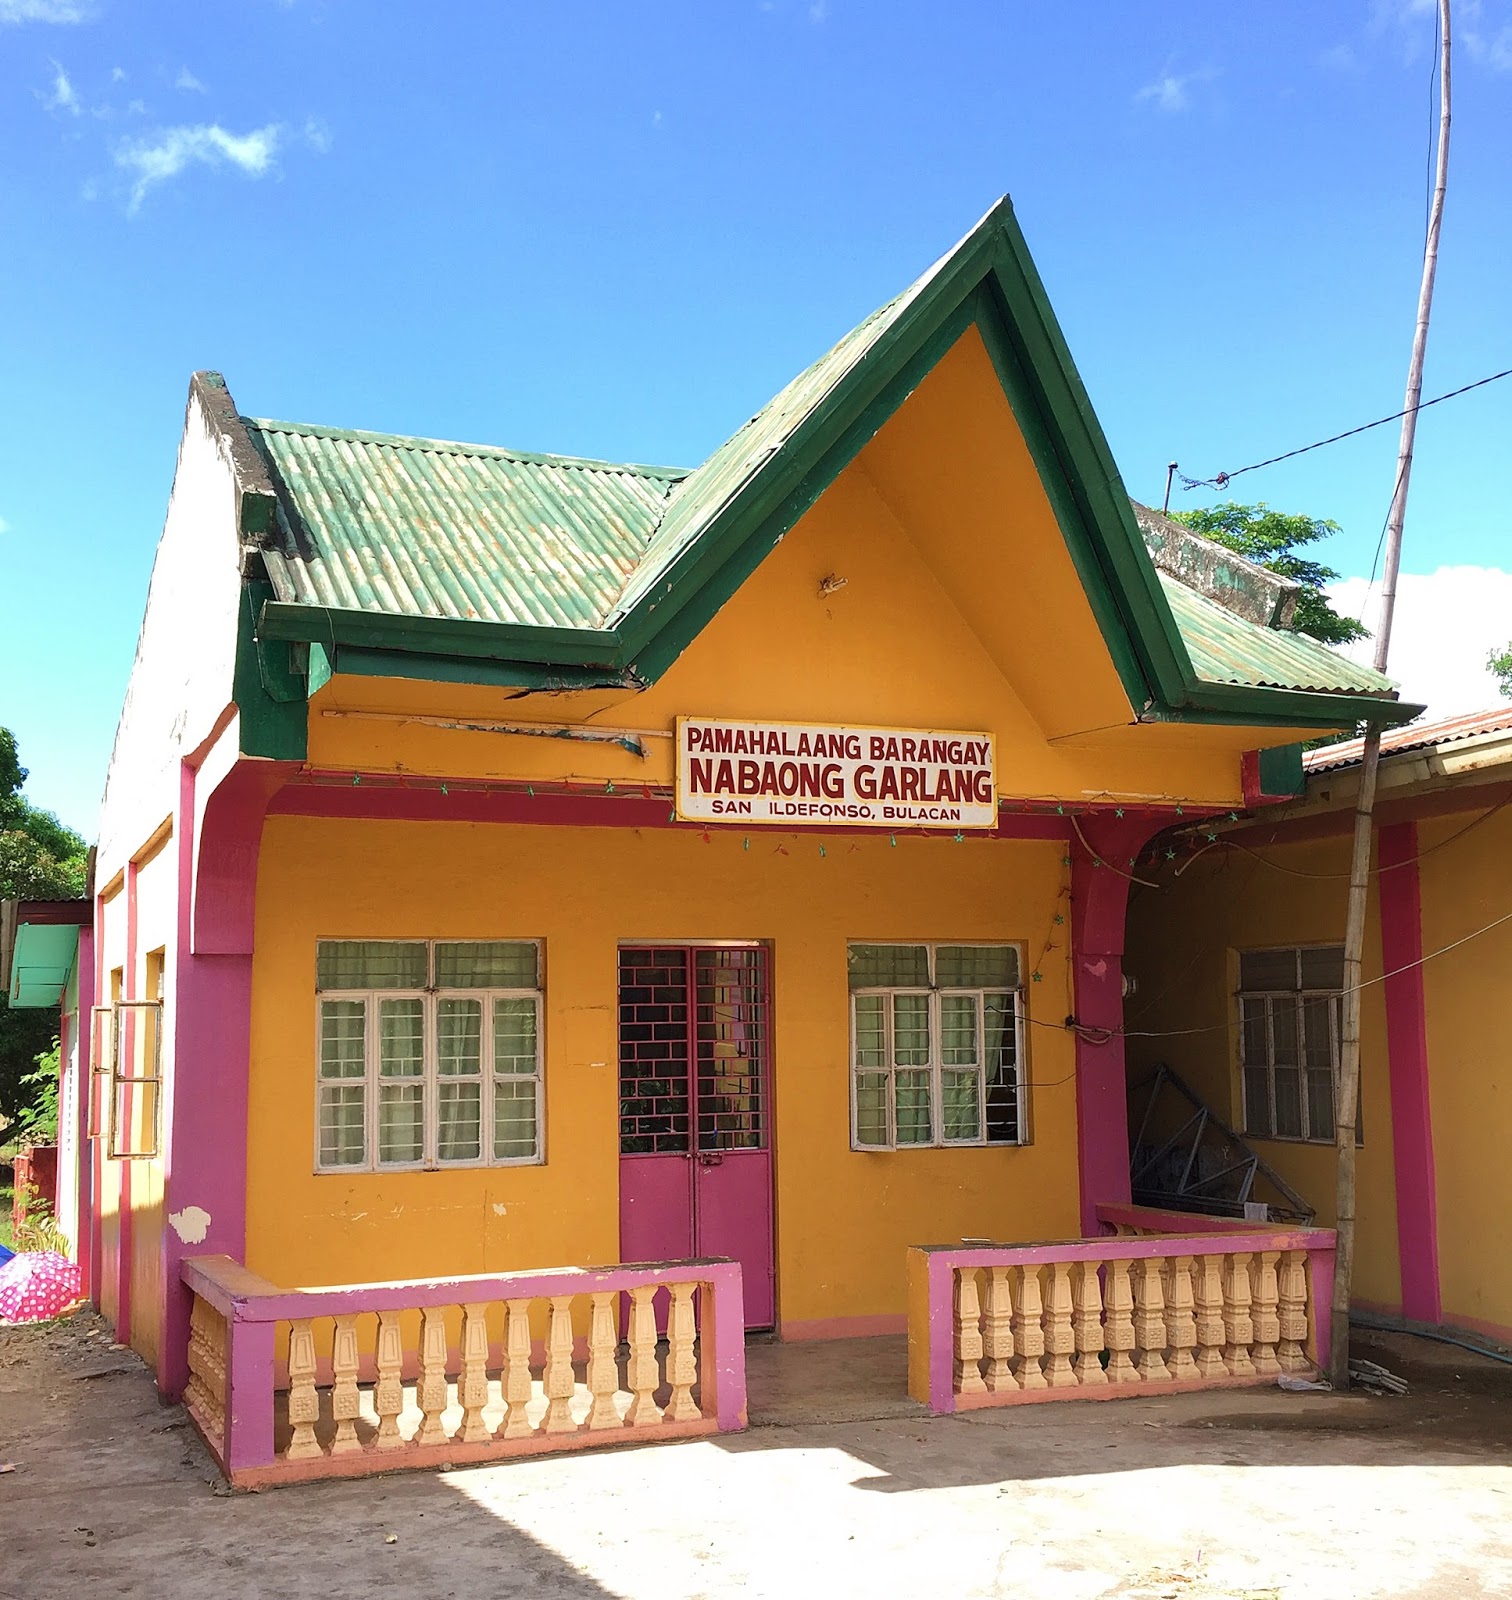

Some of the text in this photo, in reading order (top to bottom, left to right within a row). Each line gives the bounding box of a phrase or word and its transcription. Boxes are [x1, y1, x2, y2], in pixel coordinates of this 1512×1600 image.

[687, 727, 989, 766] PAMAHALAANG BARANGAY
[690, 758, 991, 803] NABAONG GARLANG
[712, 800, 961, 820] SAN ILDEFONSO, BULACAN
